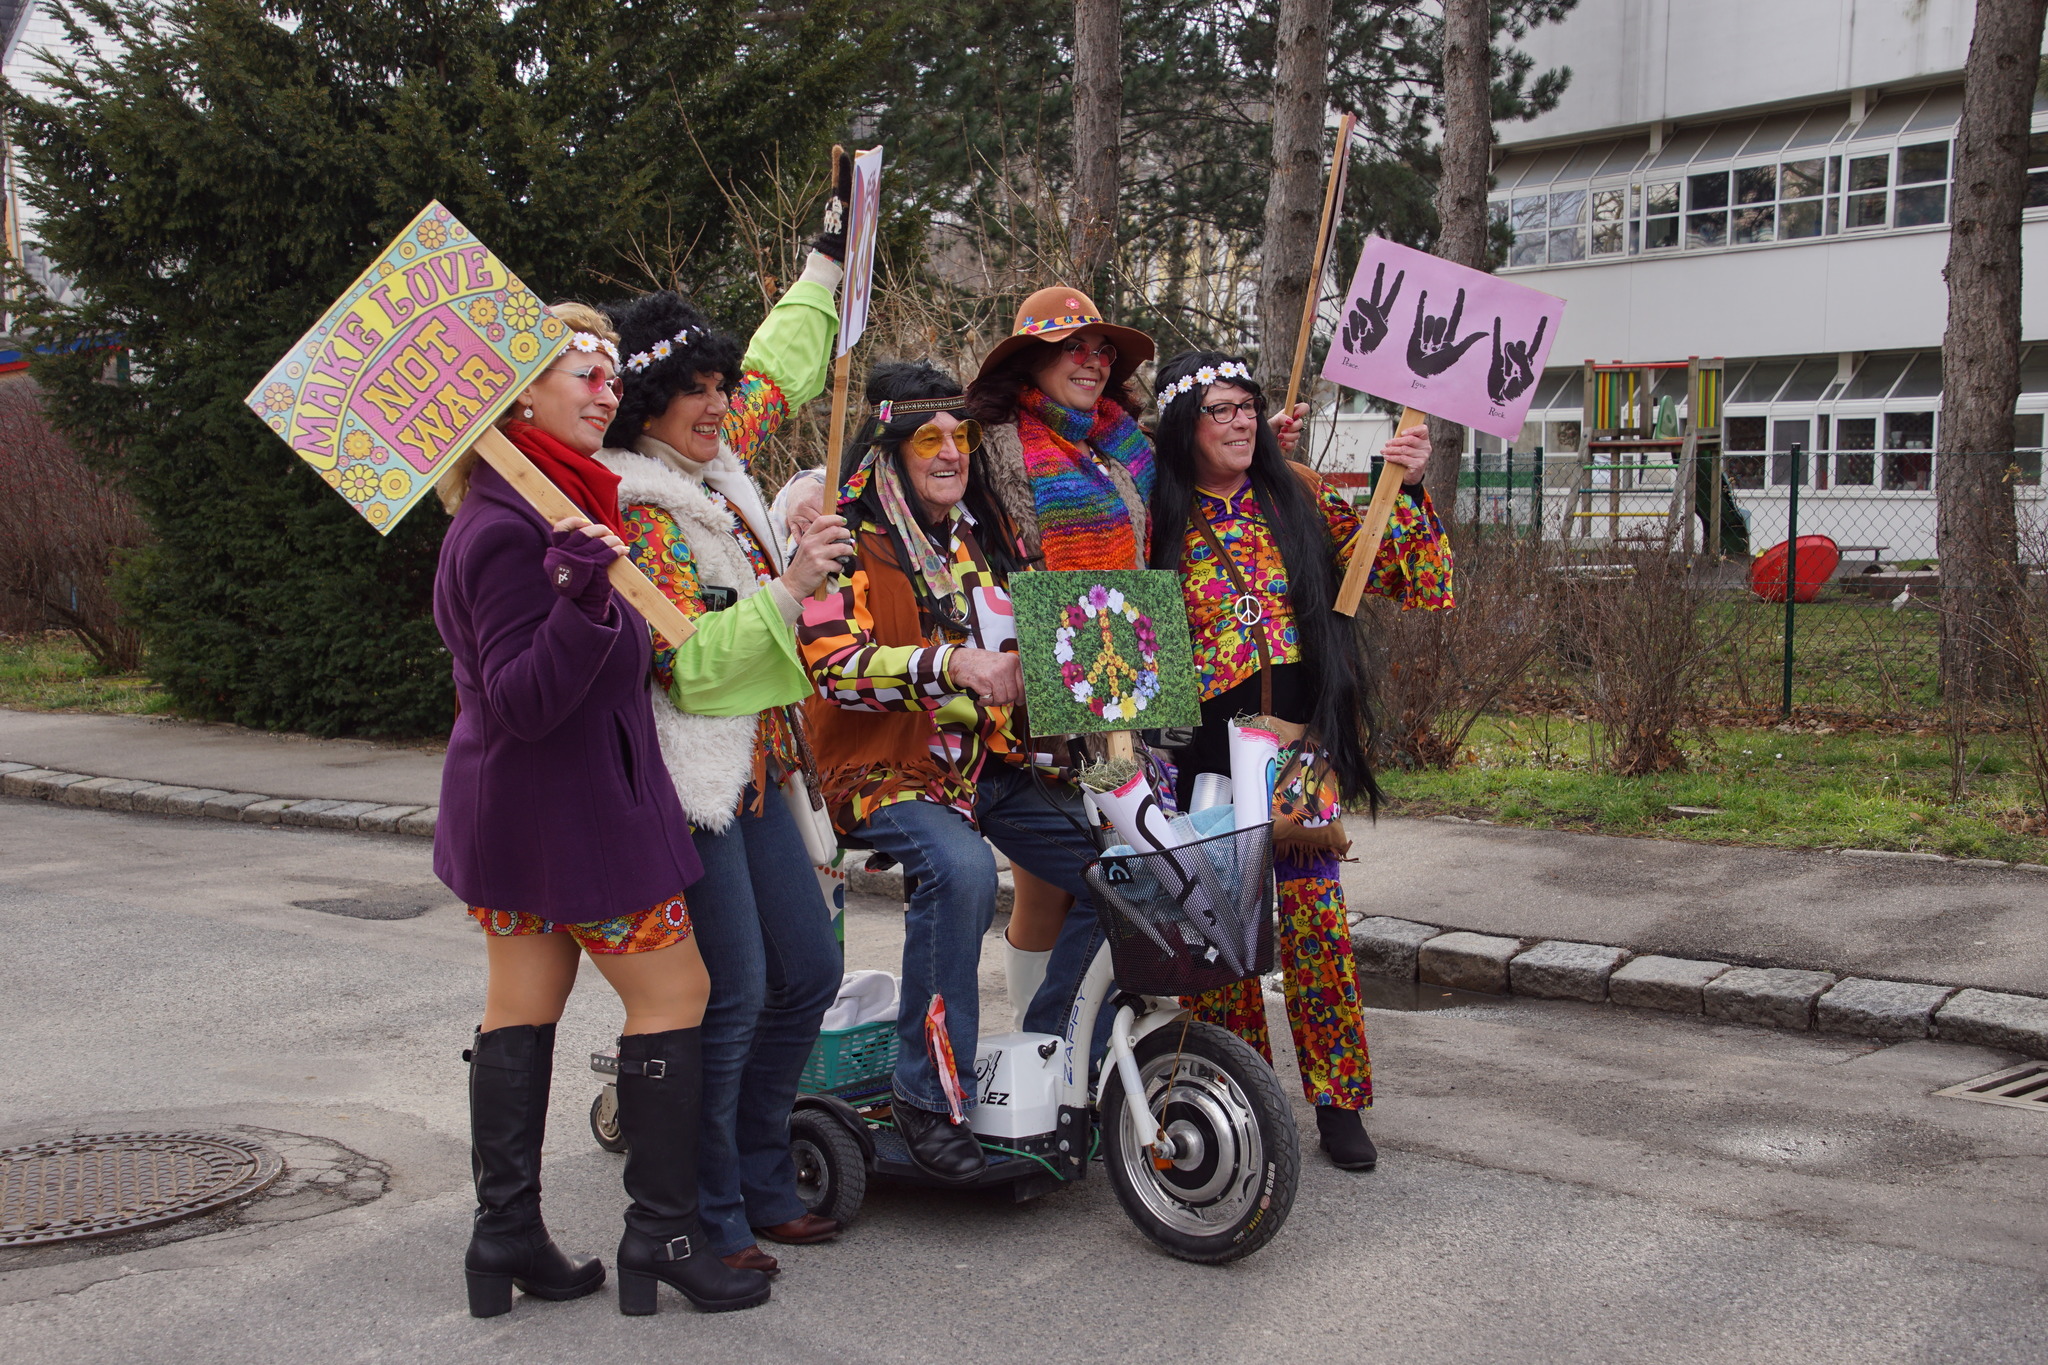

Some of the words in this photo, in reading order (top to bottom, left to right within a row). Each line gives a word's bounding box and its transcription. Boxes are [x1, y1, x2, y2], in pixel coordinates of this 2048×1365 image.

[292, 311, 383, 458] MAKE
[370, 245, 494, 328] LOVE
[361, 315, 460, 425] NOT
[397, 354, 508, 461] WAR
